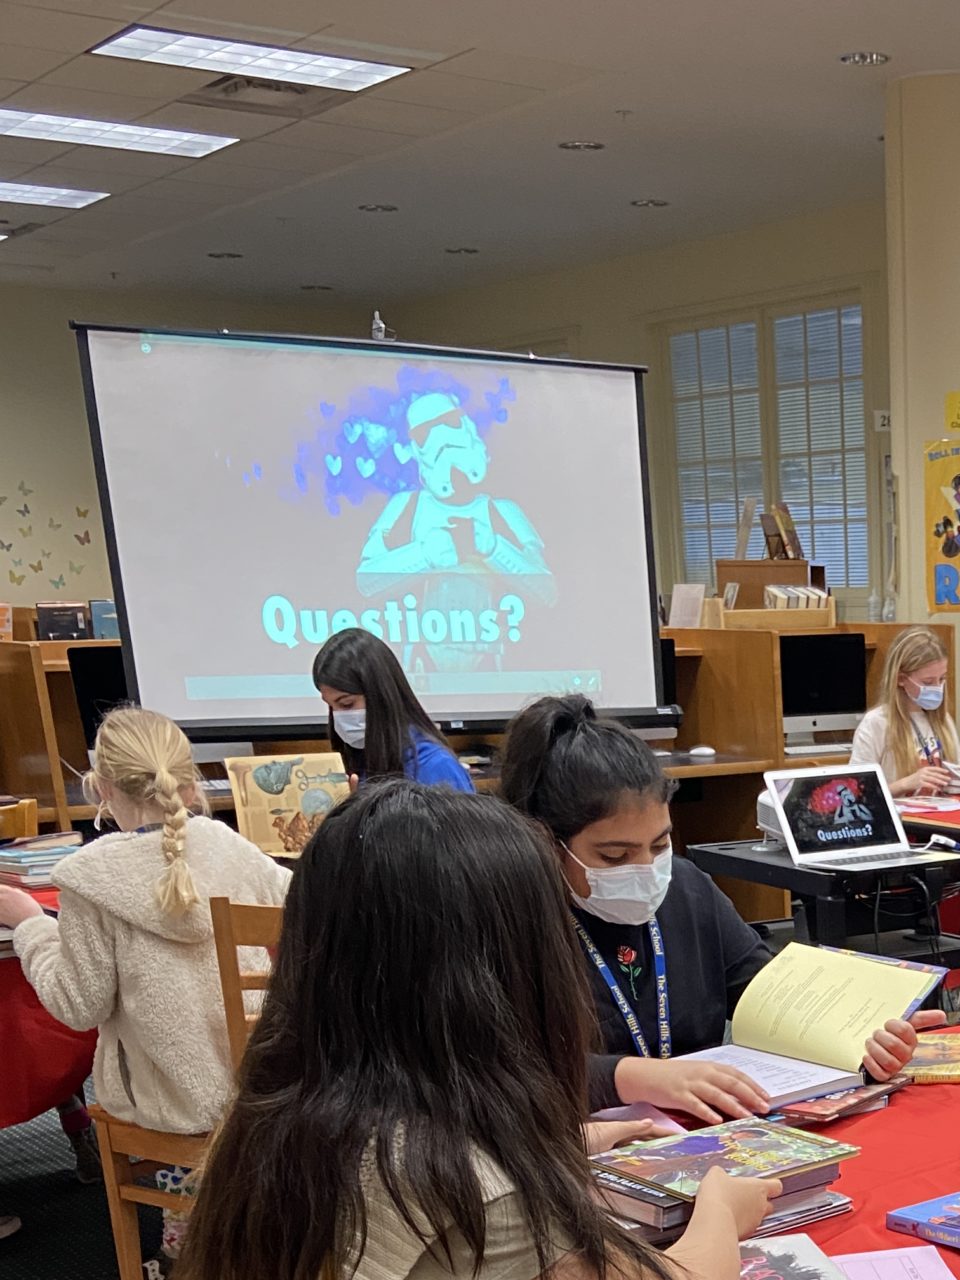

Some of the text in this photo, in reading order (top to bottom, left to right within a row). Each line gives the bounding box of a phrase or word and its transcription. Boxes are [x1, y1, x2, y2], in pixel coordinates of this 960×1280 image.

[262, 594, 525, 649] Questions?
[817, 824, 873, 842] Questions?
[650, 926, 664, 955] School
[657, 974, 667, 991] The
[610, 985, 630, 1013] School
[658, 992, 668, 1019] Seven
[626, 1014, 640, 1034] Hills
[659, 1021, 670, 1042] Hills
